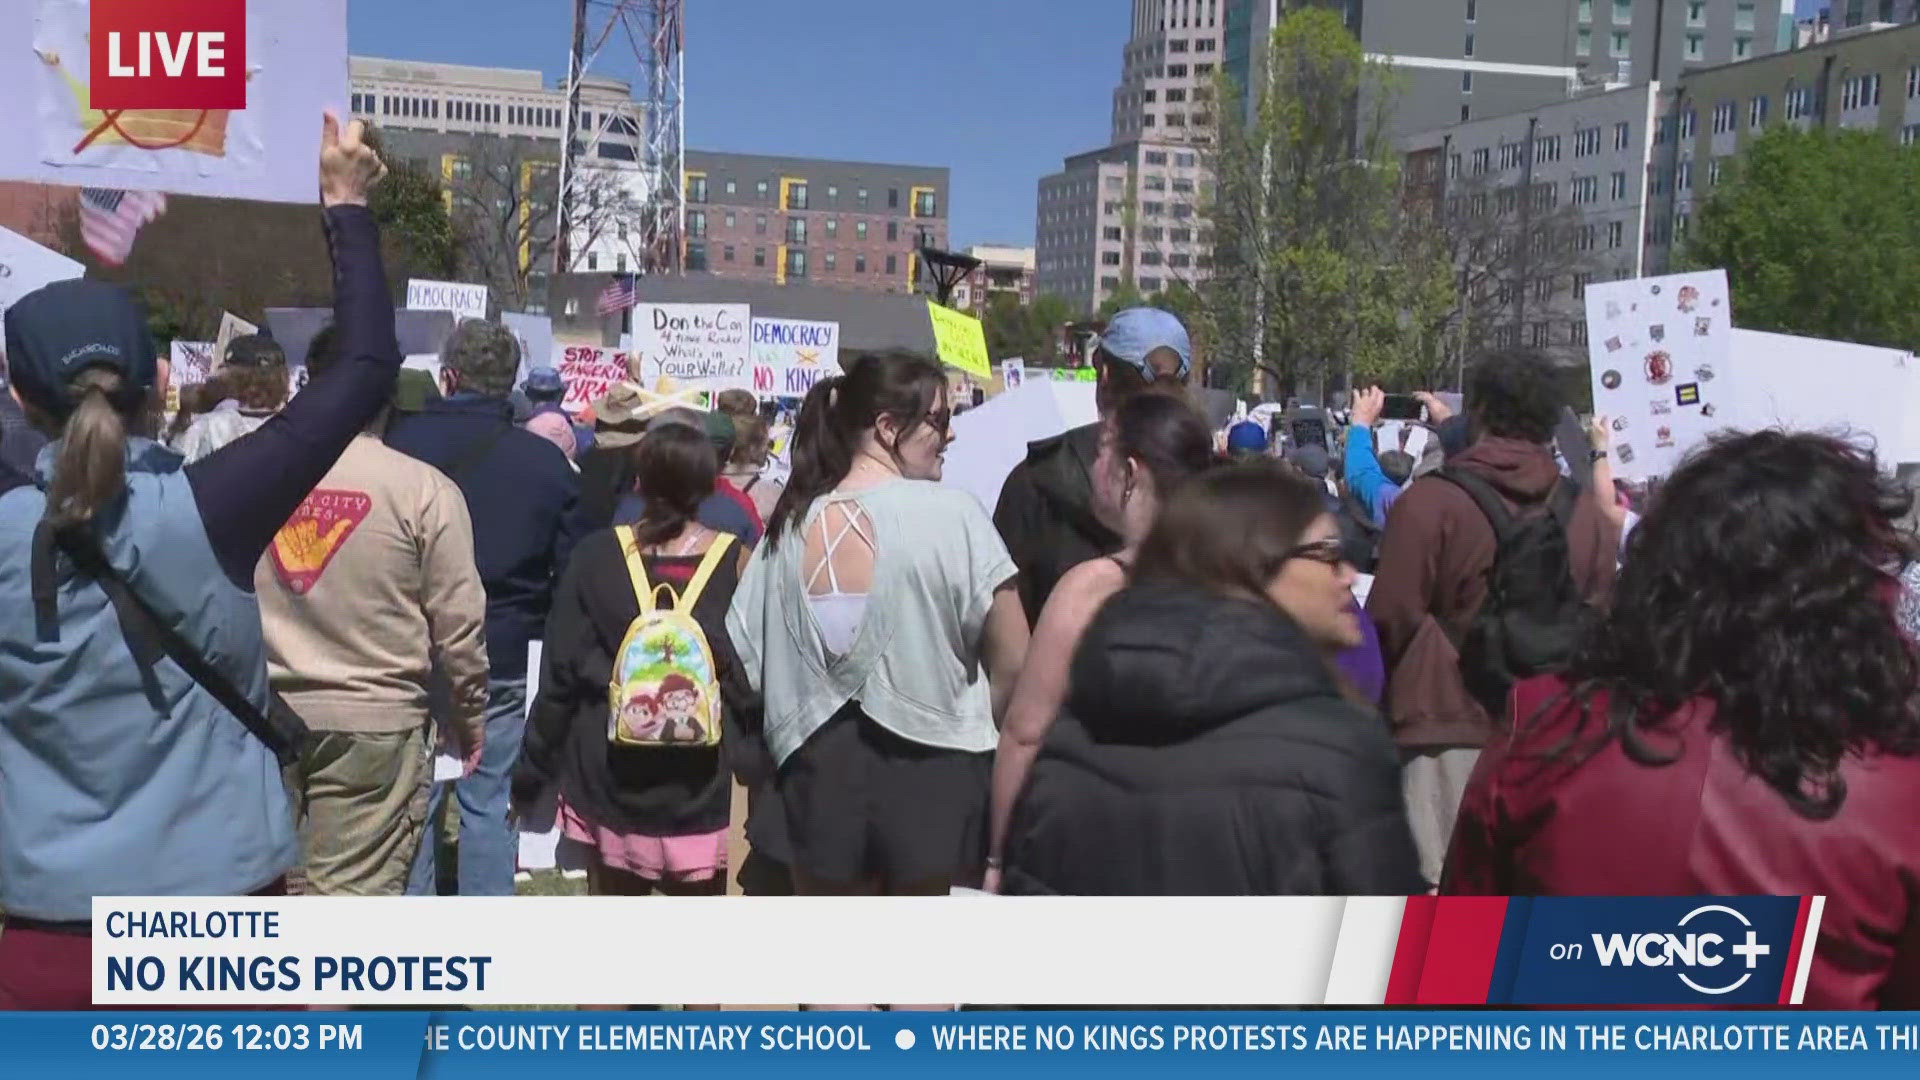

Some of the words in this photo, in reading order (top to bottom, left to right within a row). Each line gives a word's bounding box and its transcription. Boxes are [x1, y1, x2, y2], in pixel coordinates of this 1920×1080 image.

[408, 284, 484, 310] DEMOCRACY
[653, 308, 690, 331] Don
[694, 314, 713, 330] the
[716, 309, 743, 331] Con
[753, 322, 832, 347] DEMOCRACY
[565, 347, 604, 363] STOP
[711, 350, 723, 359] in
[753, 365, 775, 392] NO
[321, 494, 367, 511] CITY
